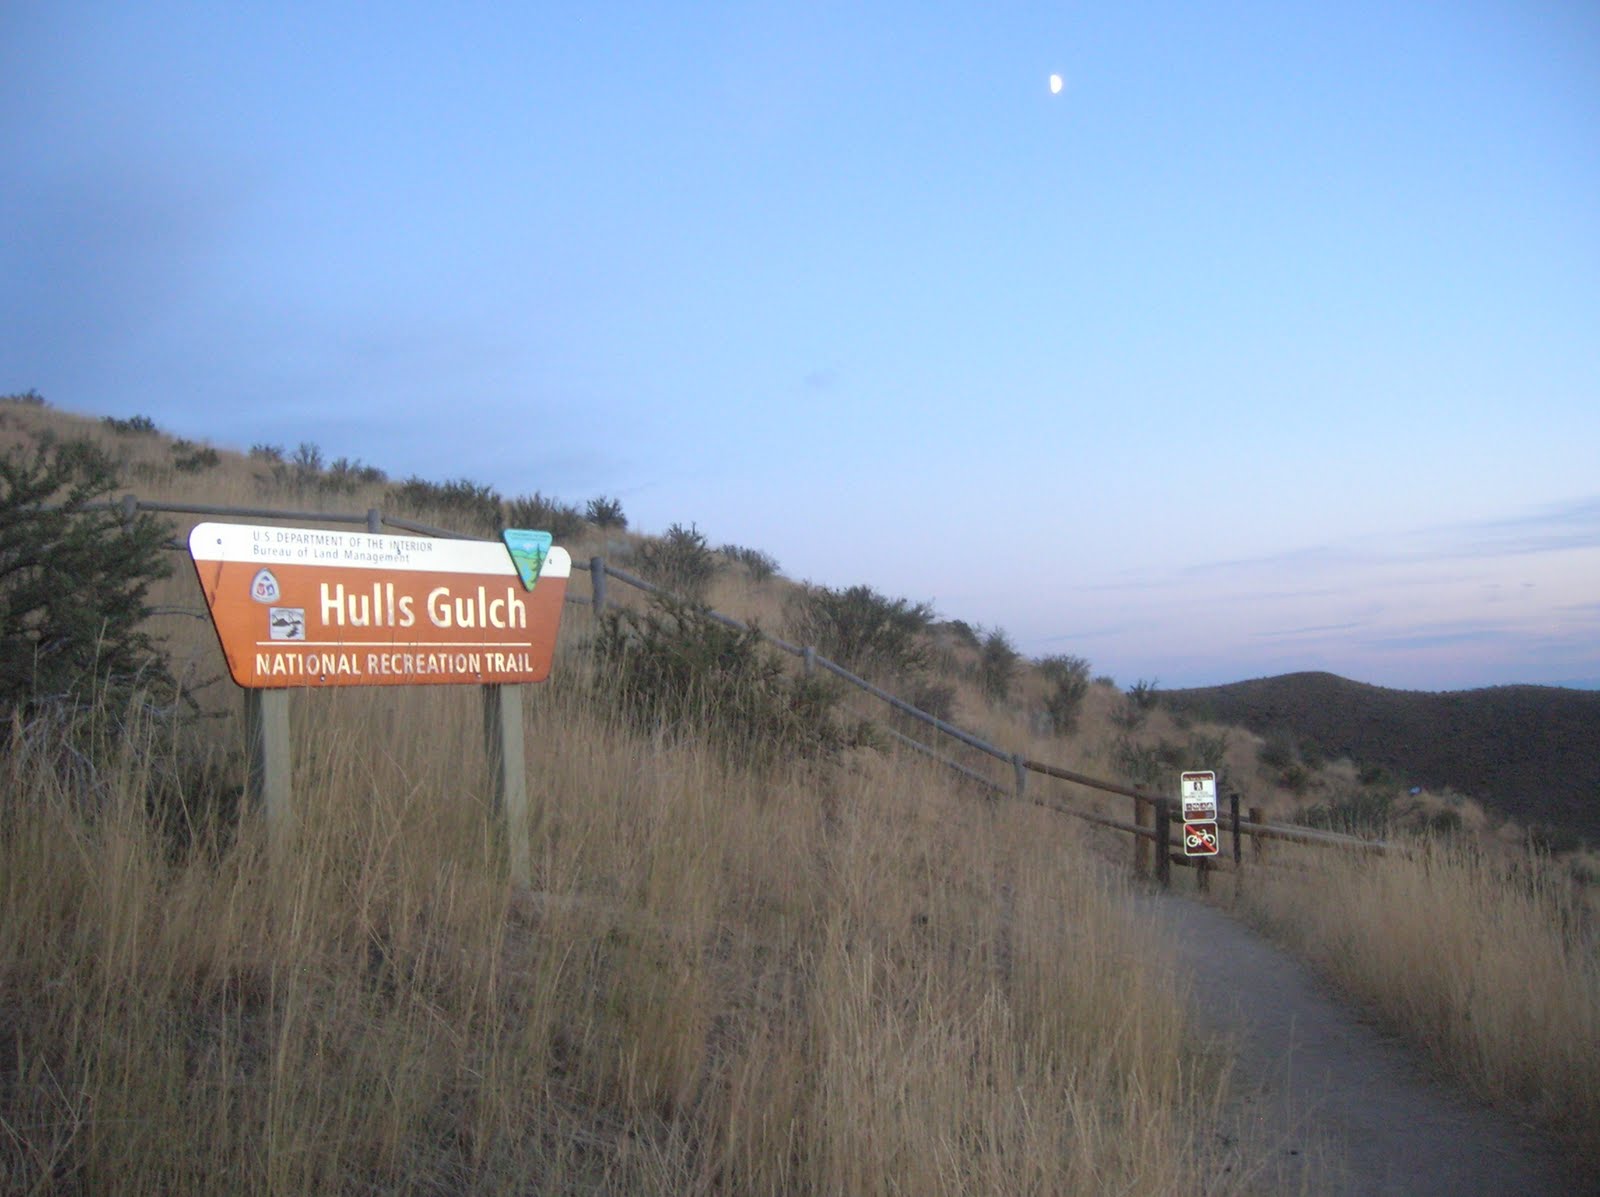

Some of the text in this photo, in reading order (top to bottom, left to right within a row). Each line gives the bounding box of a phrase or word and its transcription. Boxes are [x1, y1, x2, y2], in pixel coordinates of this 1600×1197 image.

[276, 531, 343, 547] DEPARTMENT
[350, 537, 361, 548] OF
[368, 538, 383, 549] THE
[389, 540, 433, 553] INTERIOR
[253, 544, 409, 565] Bureau of Land Management
[320, 582, 527, 629] Hulls Gulch
[255, 653, 533, 676] NATIONAL RECREATION TRAIL
